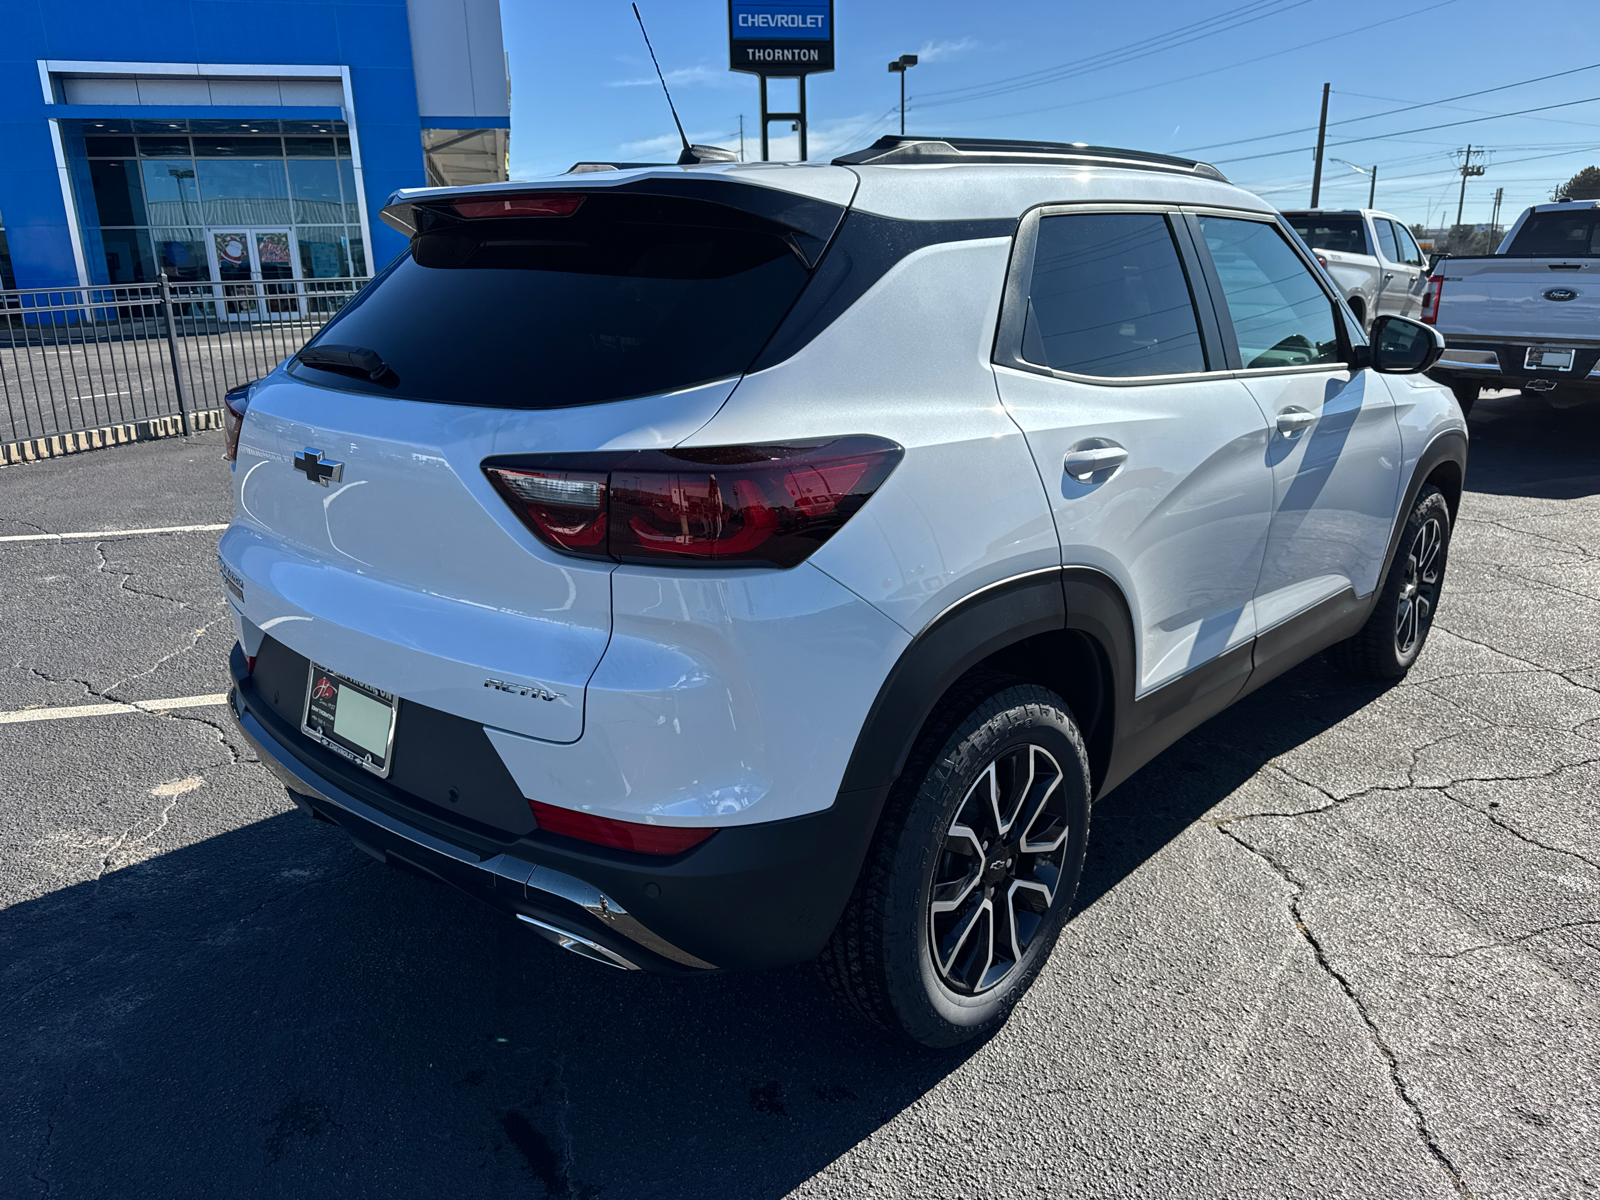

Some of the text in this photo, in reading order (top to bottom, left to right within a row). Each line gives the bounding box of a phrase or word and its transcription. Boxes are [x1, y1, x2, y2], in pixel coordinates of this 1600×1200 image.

[738, 13, 825, 28] CHEVROLET
[746, 48, 819, 61] THORNTON
[483, 677, 567, 702] ACTIV
[328, 743, 355, 761] CHEVROLET
